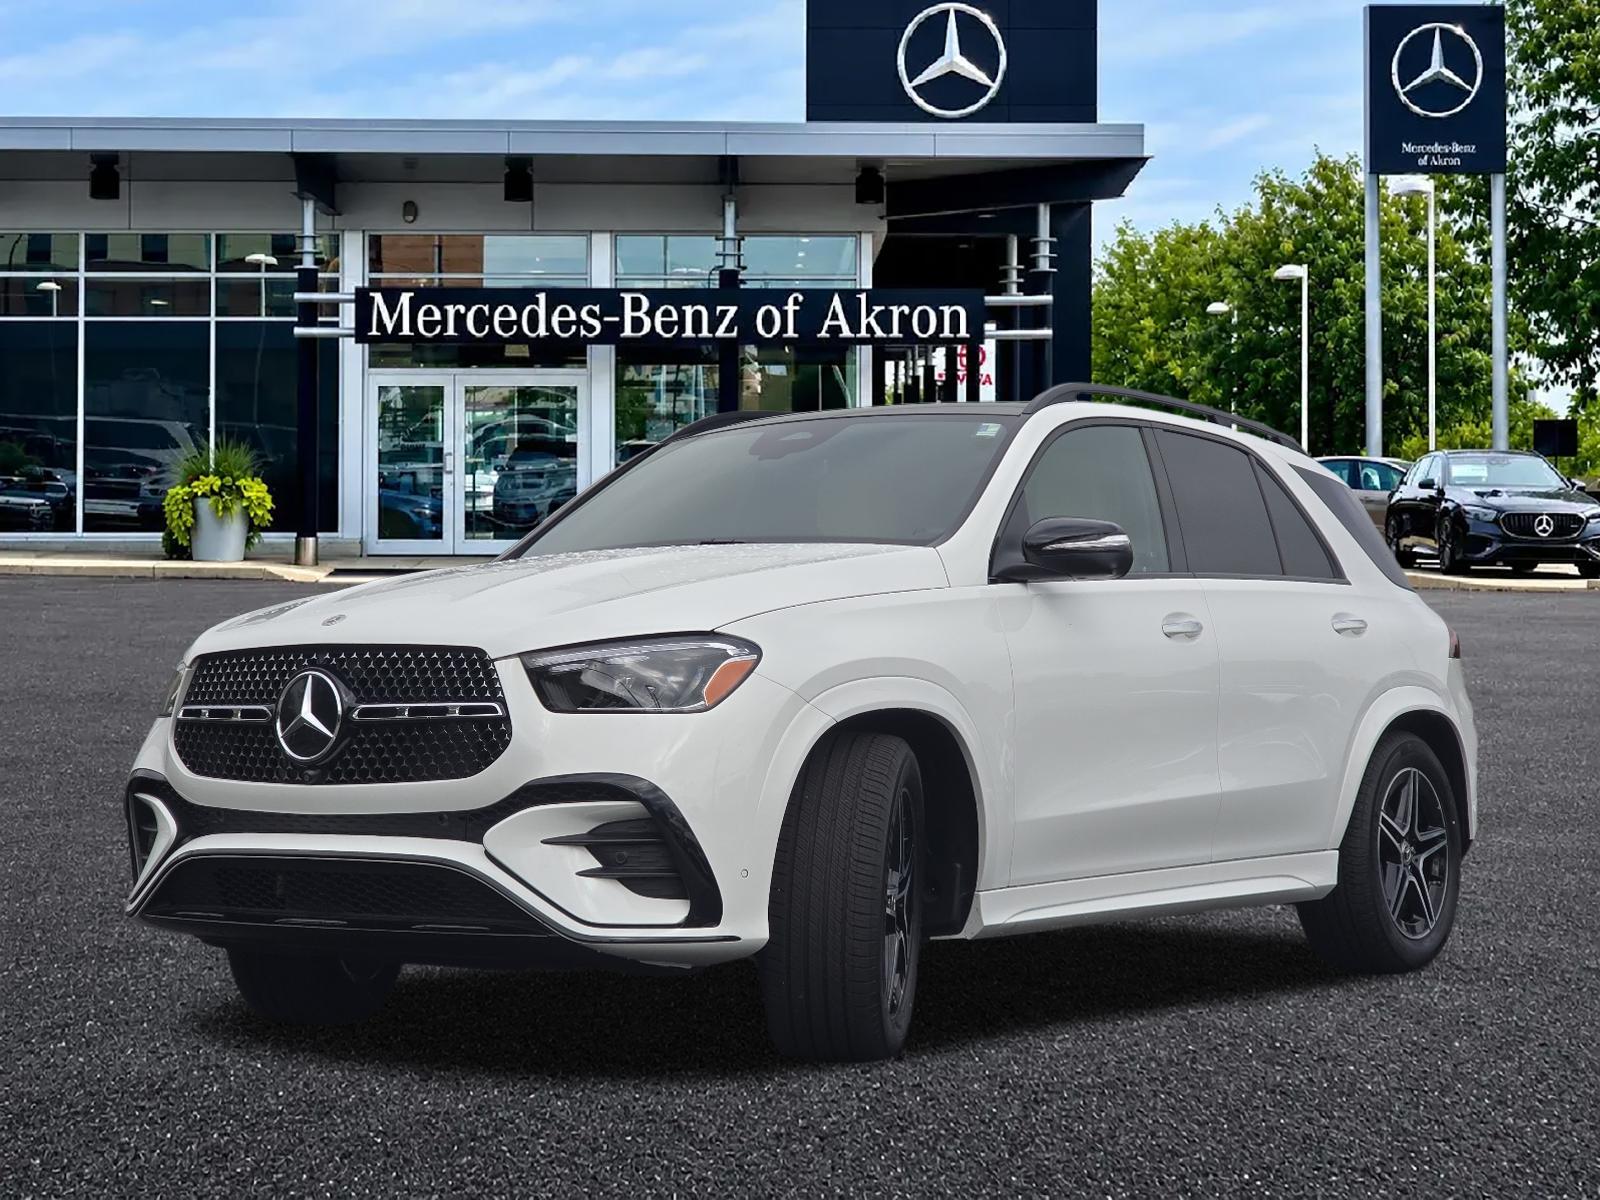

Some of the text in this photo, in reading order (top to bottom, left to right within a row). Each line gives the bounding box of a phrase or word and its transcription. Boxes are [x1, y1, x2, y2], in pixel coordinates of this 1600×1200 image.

[1401, 141, 1477, 154] Mercedes-Benz
[1417, 154, 1461, 166] of Akron
[367, 291, 970, 338] Mercedes-Benz of Akron
